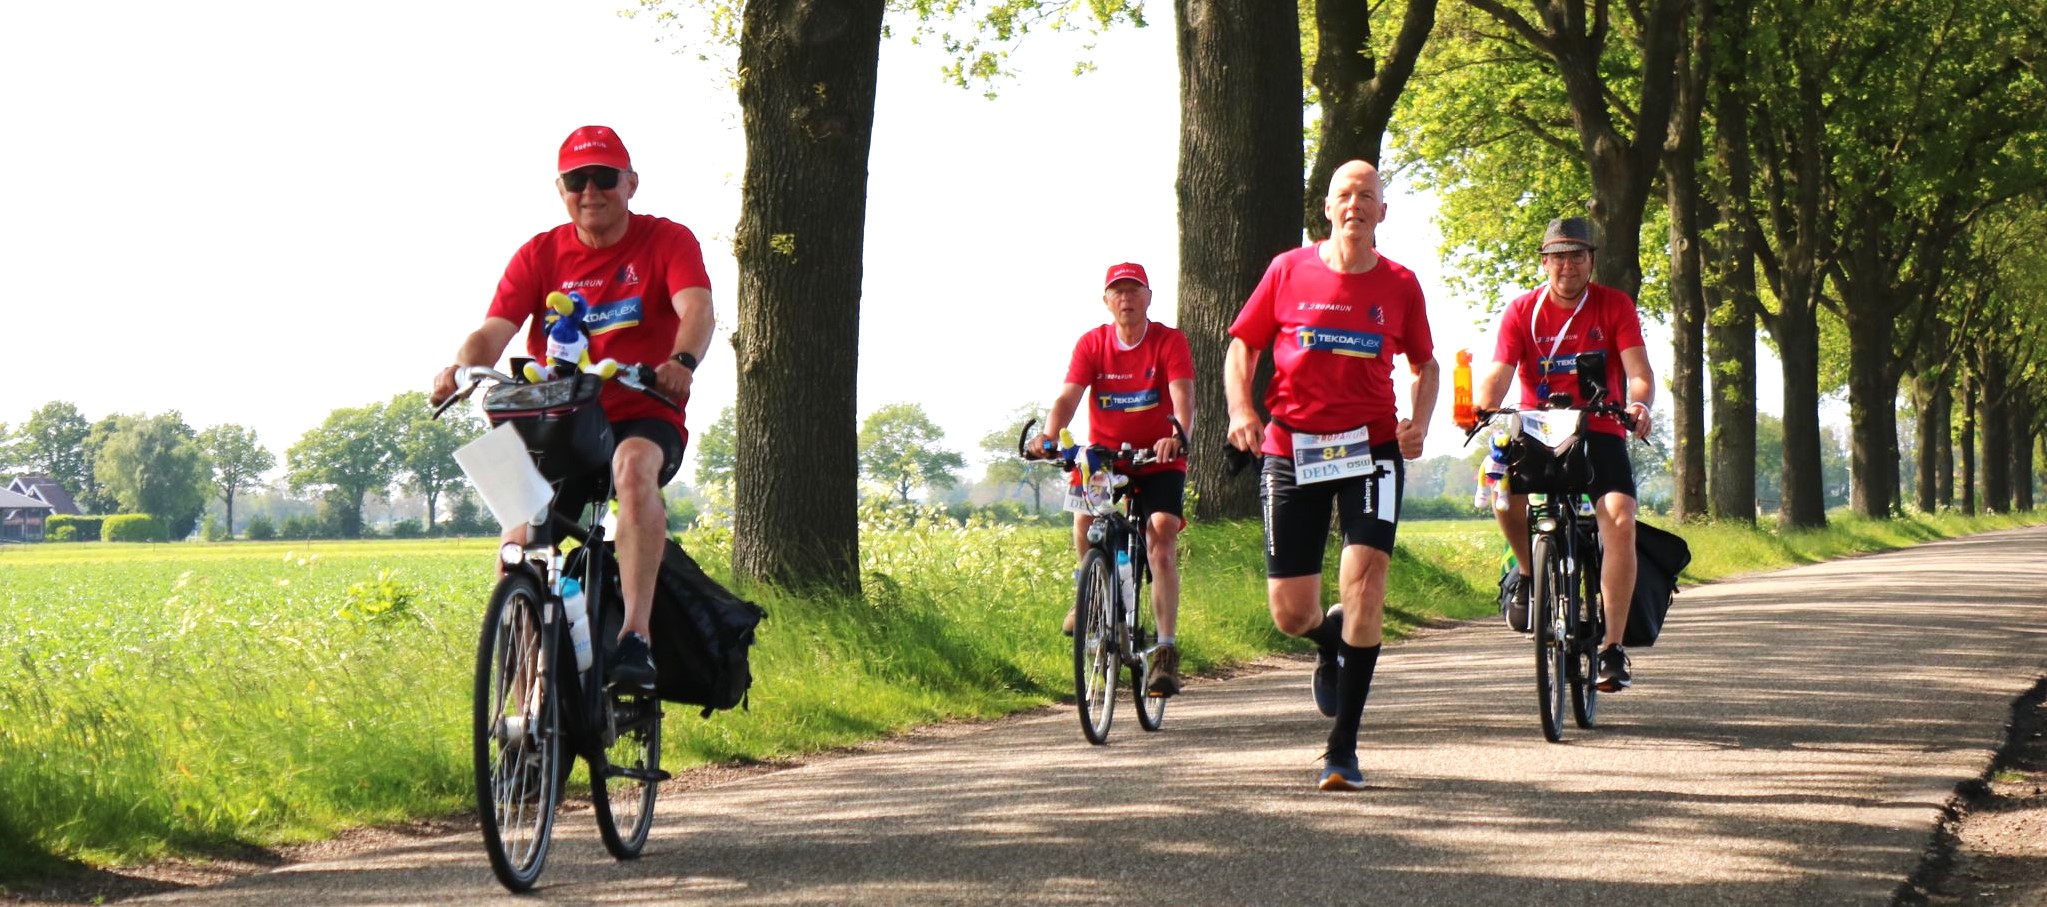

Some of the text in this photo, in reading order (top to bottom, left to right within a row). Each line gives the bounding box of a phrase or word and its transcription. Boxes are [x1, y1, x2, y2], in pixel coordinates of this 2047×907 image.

[562, 280, 603, 289] ROPARUN
[1314, 303, 1352, 312] ROPARUN
[1322, 445, 1348, 460] 84
